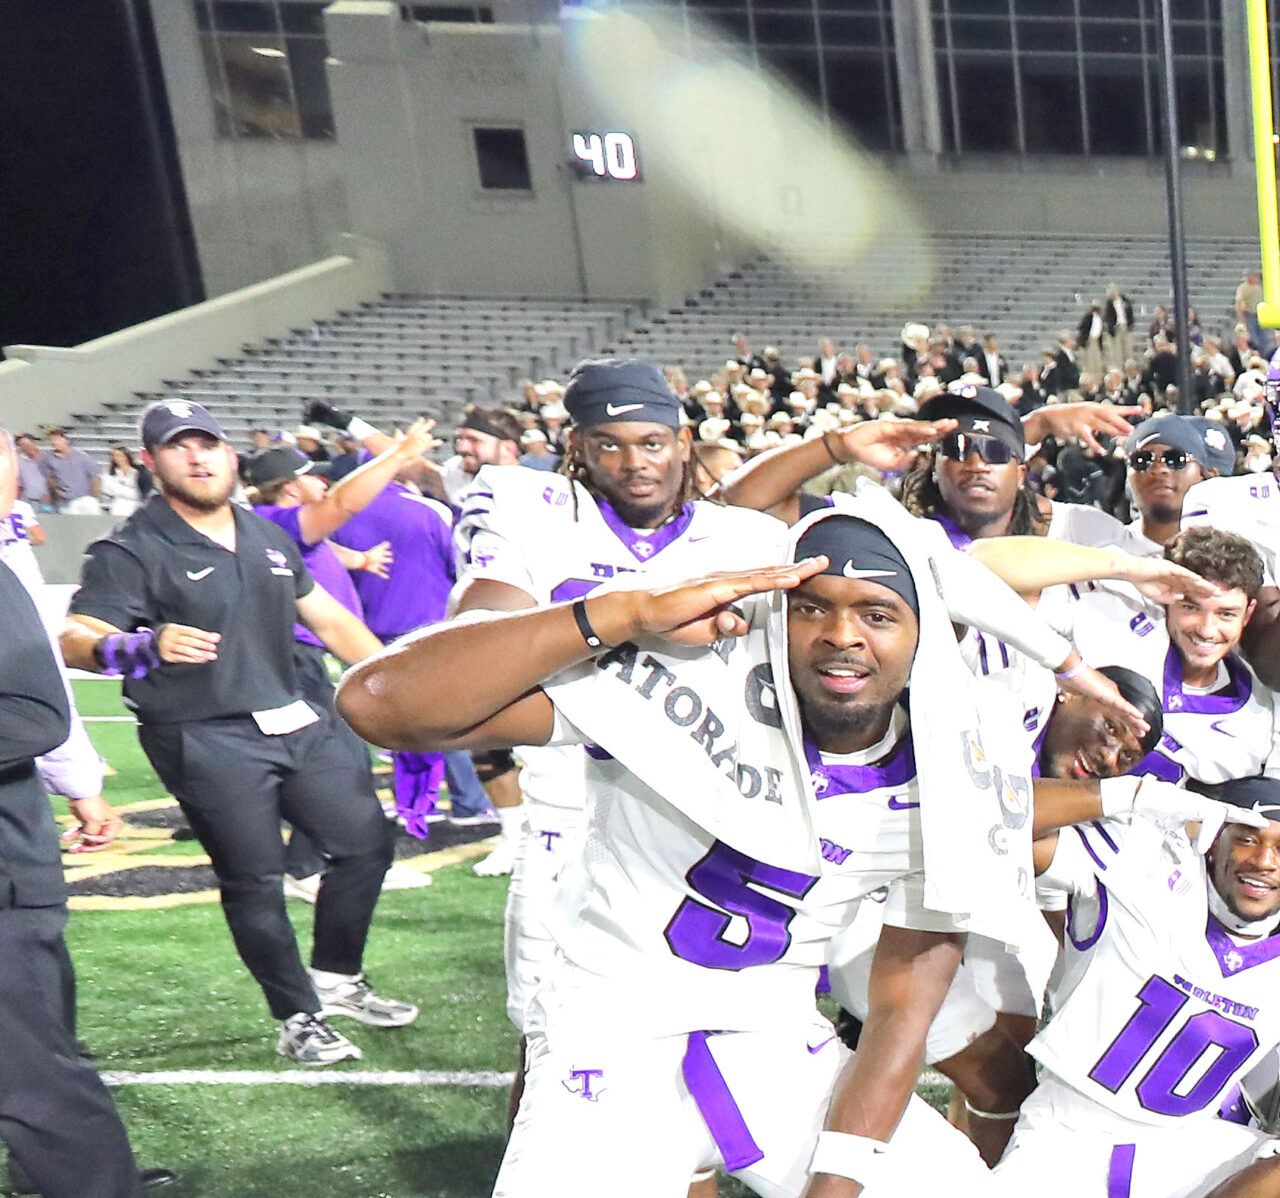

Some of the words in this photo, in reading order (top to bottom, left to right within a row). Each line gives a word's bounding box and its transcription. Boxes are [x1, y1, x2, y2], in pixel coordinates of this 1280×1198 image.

[573, 133, 637, 179] 40
[597, 640, 783, 806] ATORADE
[662, 837, 821, 972] 5
[1087, 973, 1261, 1118] 10
